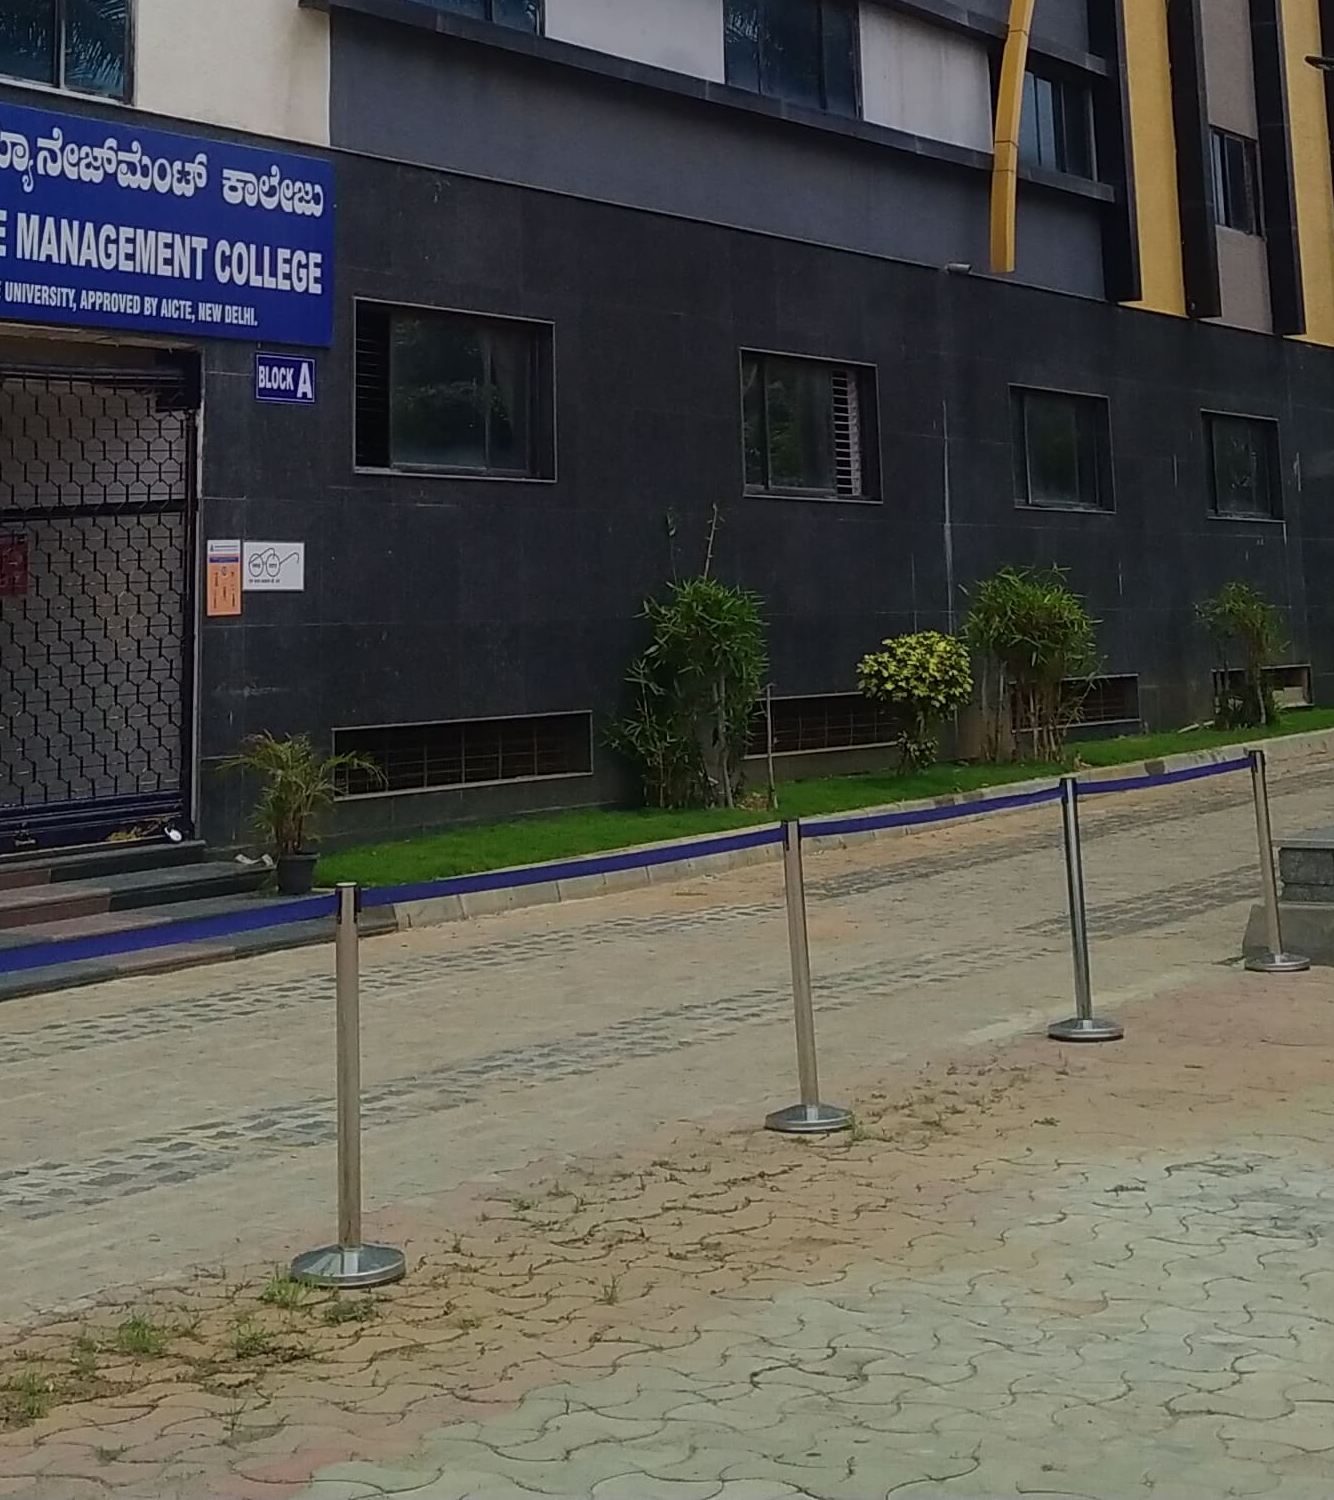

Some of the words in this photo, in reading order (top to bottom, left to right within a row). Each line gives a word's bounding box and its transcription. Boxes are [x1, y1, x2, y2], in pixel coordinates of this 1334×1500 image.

[222, 165, 323, 217] ಕಾಲೇಜು
[17, 213, 207, 280] MANAGEMENT
[215, 240, 322, 294] COLLEGE
[5, 281, 77, 312] UNIVERSITY,
[80, 289, 141, 315] APPROVED
[144, 296, 158, 317] BY
[160, 298, 196, 323] AICTE,
[198, 302, 222, 323] NEW
[225, 305, 258, 327] DELHI.
[258, 365, 294, 391] BLOCK
[296, 362, 313, 399] A
